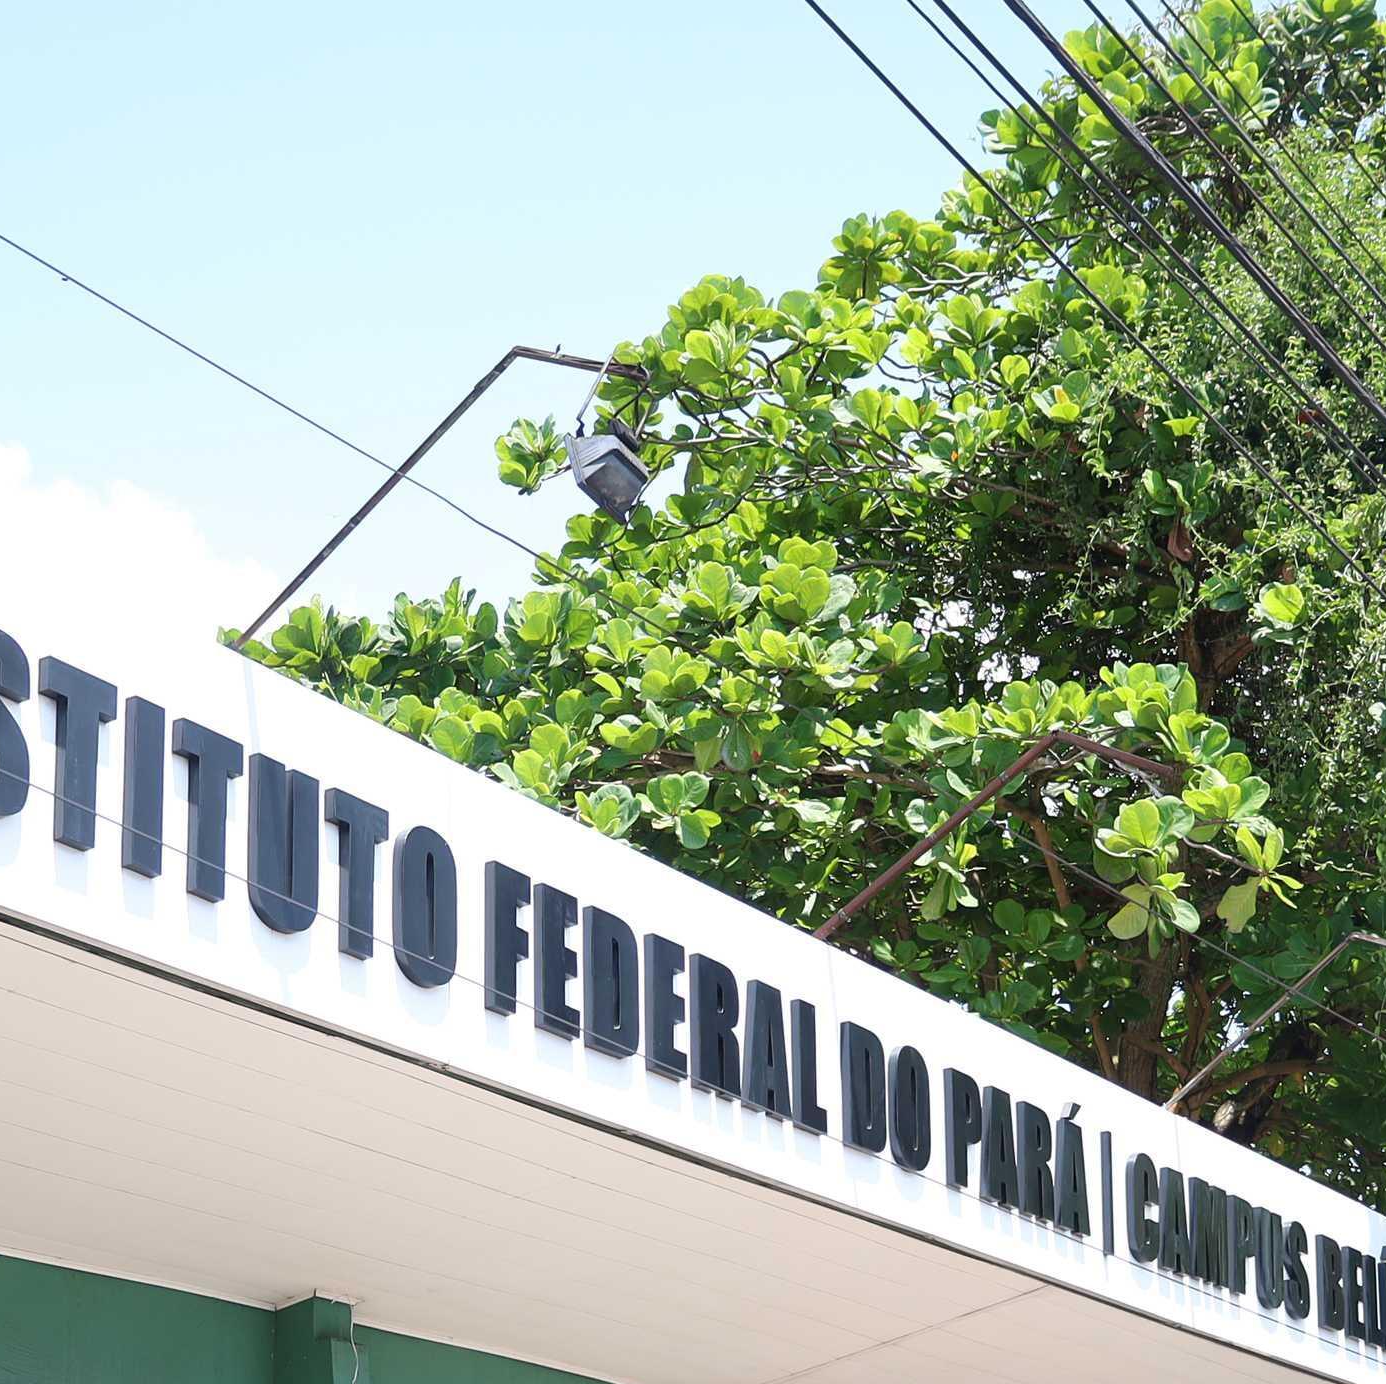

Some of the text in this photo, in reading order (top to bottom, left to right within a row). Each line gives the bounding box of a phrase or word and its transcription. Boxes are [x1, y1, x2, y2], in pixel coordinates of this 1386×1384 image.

[484, 860, 828, 1136] FEDERAL
[839, 1020, 932, 1172] DO
[942, 1066, 1091, 1238] PARÁ
[1124, 1152, 1311, 1321] CAMPUS
